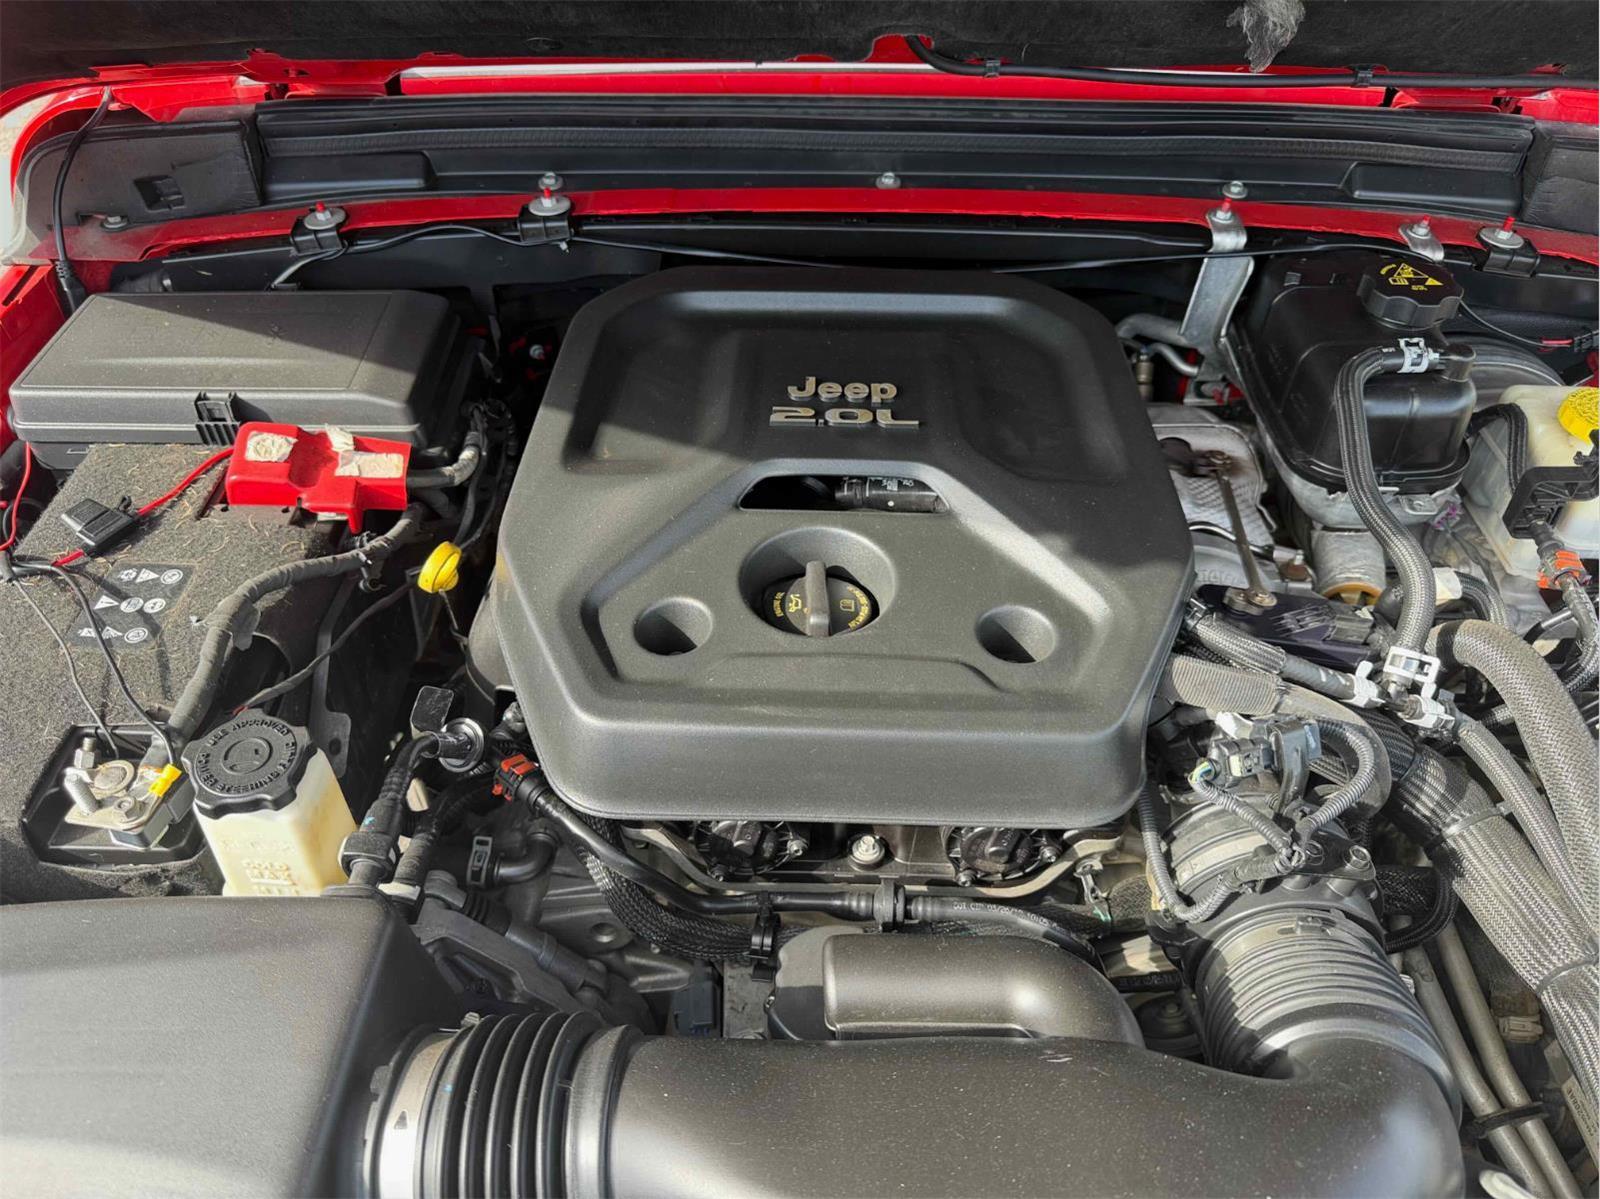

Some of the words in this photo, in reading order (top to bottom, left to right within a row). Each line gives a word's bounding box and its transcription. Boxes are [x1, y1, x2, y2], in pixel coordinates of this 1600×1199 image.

[787, 376, 898, 406] Jeep
[769, 406, 919, 429] 2.0L
[232, 719, 291, 736] APPROVED
